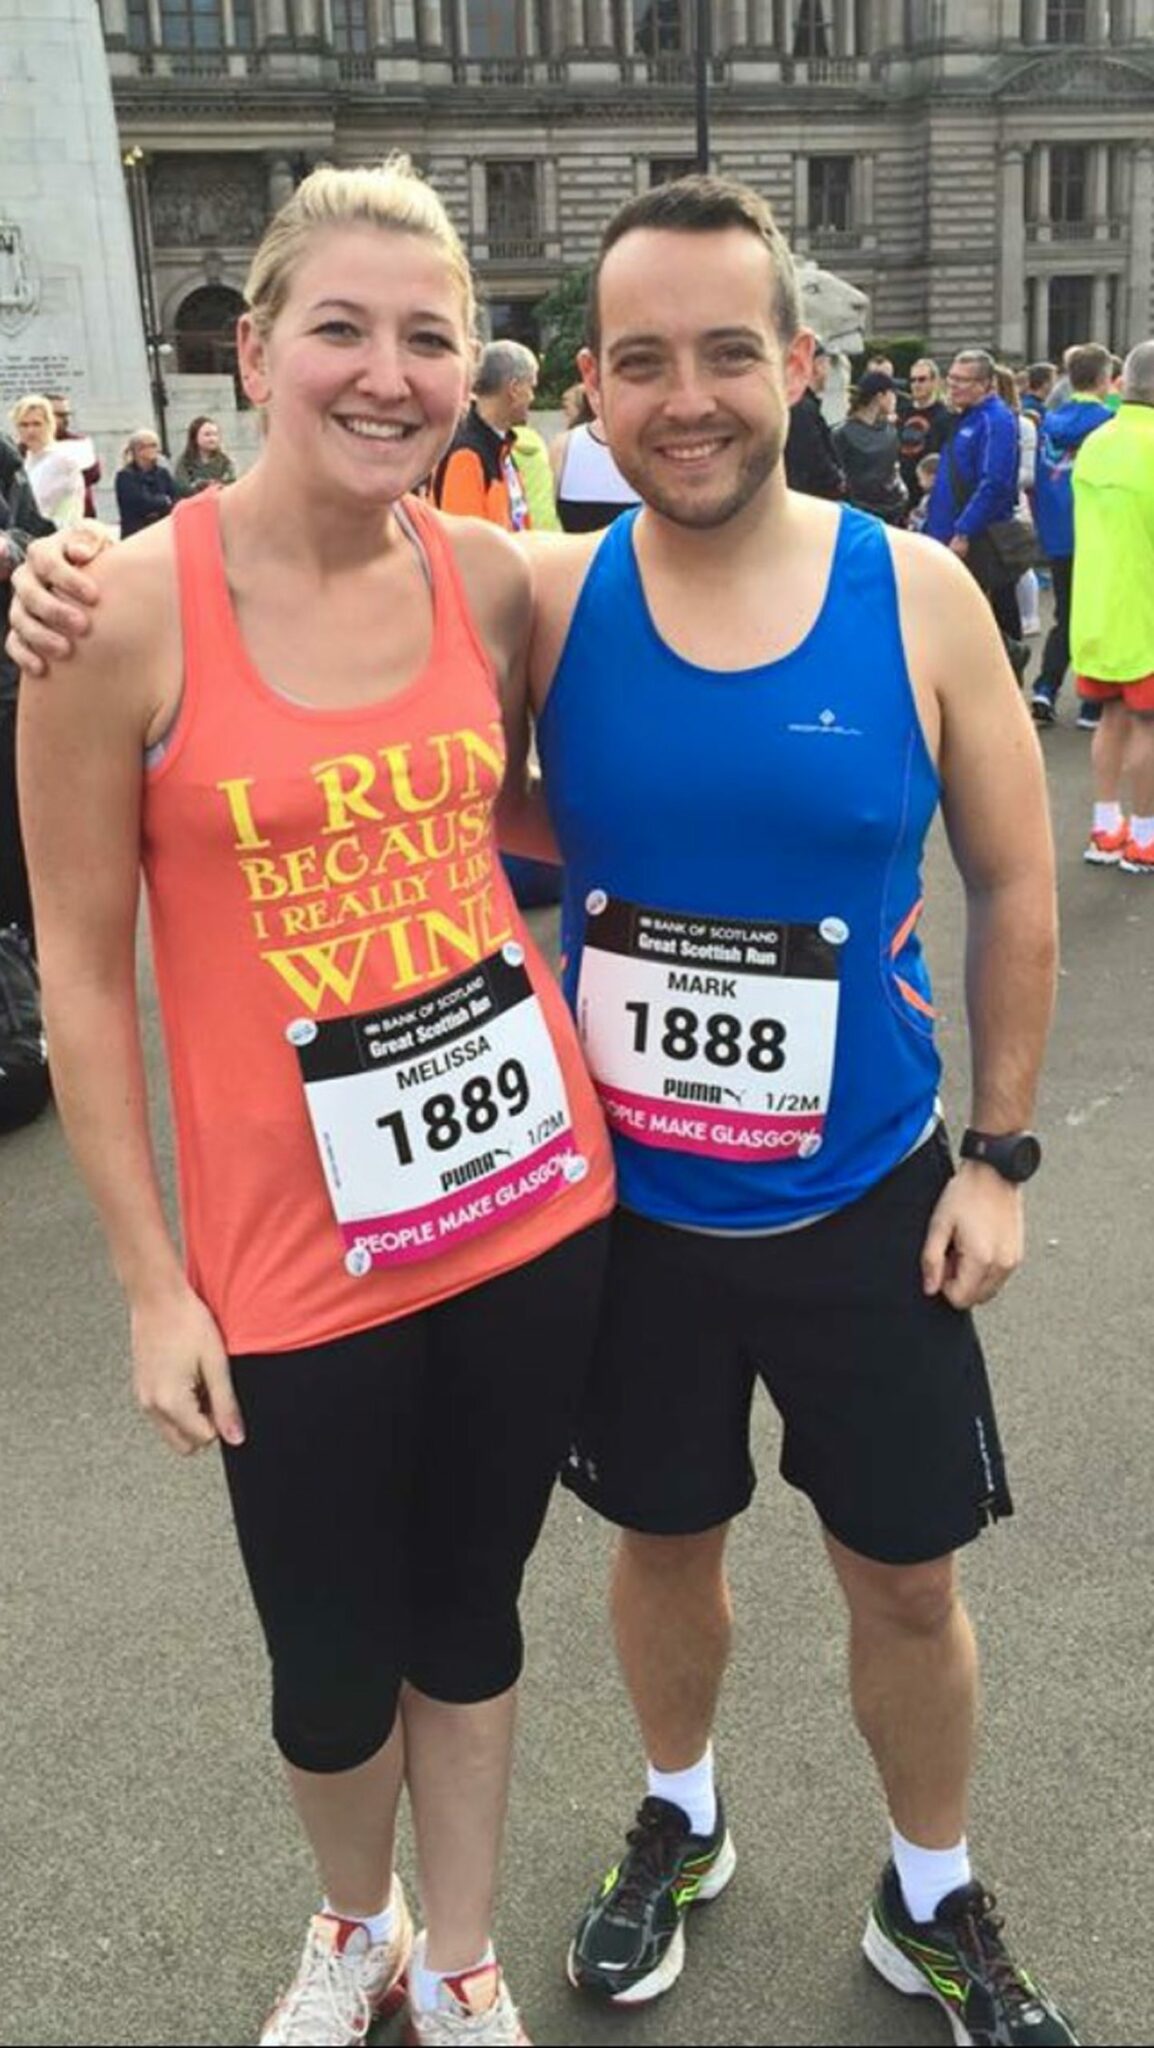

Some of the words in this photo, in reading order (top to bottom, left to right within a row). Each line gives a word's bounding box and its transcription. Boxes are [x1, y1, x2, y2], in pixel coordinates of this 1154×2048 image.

[216, 777, 271, 850] I
[309, 721, 505, 836] RUN
[253, 911, 269, 939] I
[281, 869, 433, 936] REALLY
[638, 932, 677, 954] Great
[680, 939, 742, 962] Scottish
[745, 947, 777, 966] Run
[654, 919, 686, 934] BANK
[688, 924, 706, 937] OF
[710, 927, 778, 943] SCOTLAND
[382, 1010, 417, 1032] BANK
[418, 1002, 434, 1018] OF
[437, 975, 485, 1010] SCOTLAND
[667, 971, 737, 998] MARK
[369, 1031, 415, 1058] Great
[416, 1007, 470, 1043] Scottish
[468, 995, 492, 1018] Run
[625, 1001, 787, 1074] 1888
[396, 1035, 492, 1090] MELISSA
[663, 1078, 722, 1104] PUMA
[765, 1092, 820, 1112] 1/2M
[375, 1058, 530, 1167] 1889
[527, 1111, 565, 1146] 1/2M
[650, 1114, 708, 1141] MAKE
[440, 1151, 496, 1192] PUMA
[439, 1198, 494, 1235] MAKE
